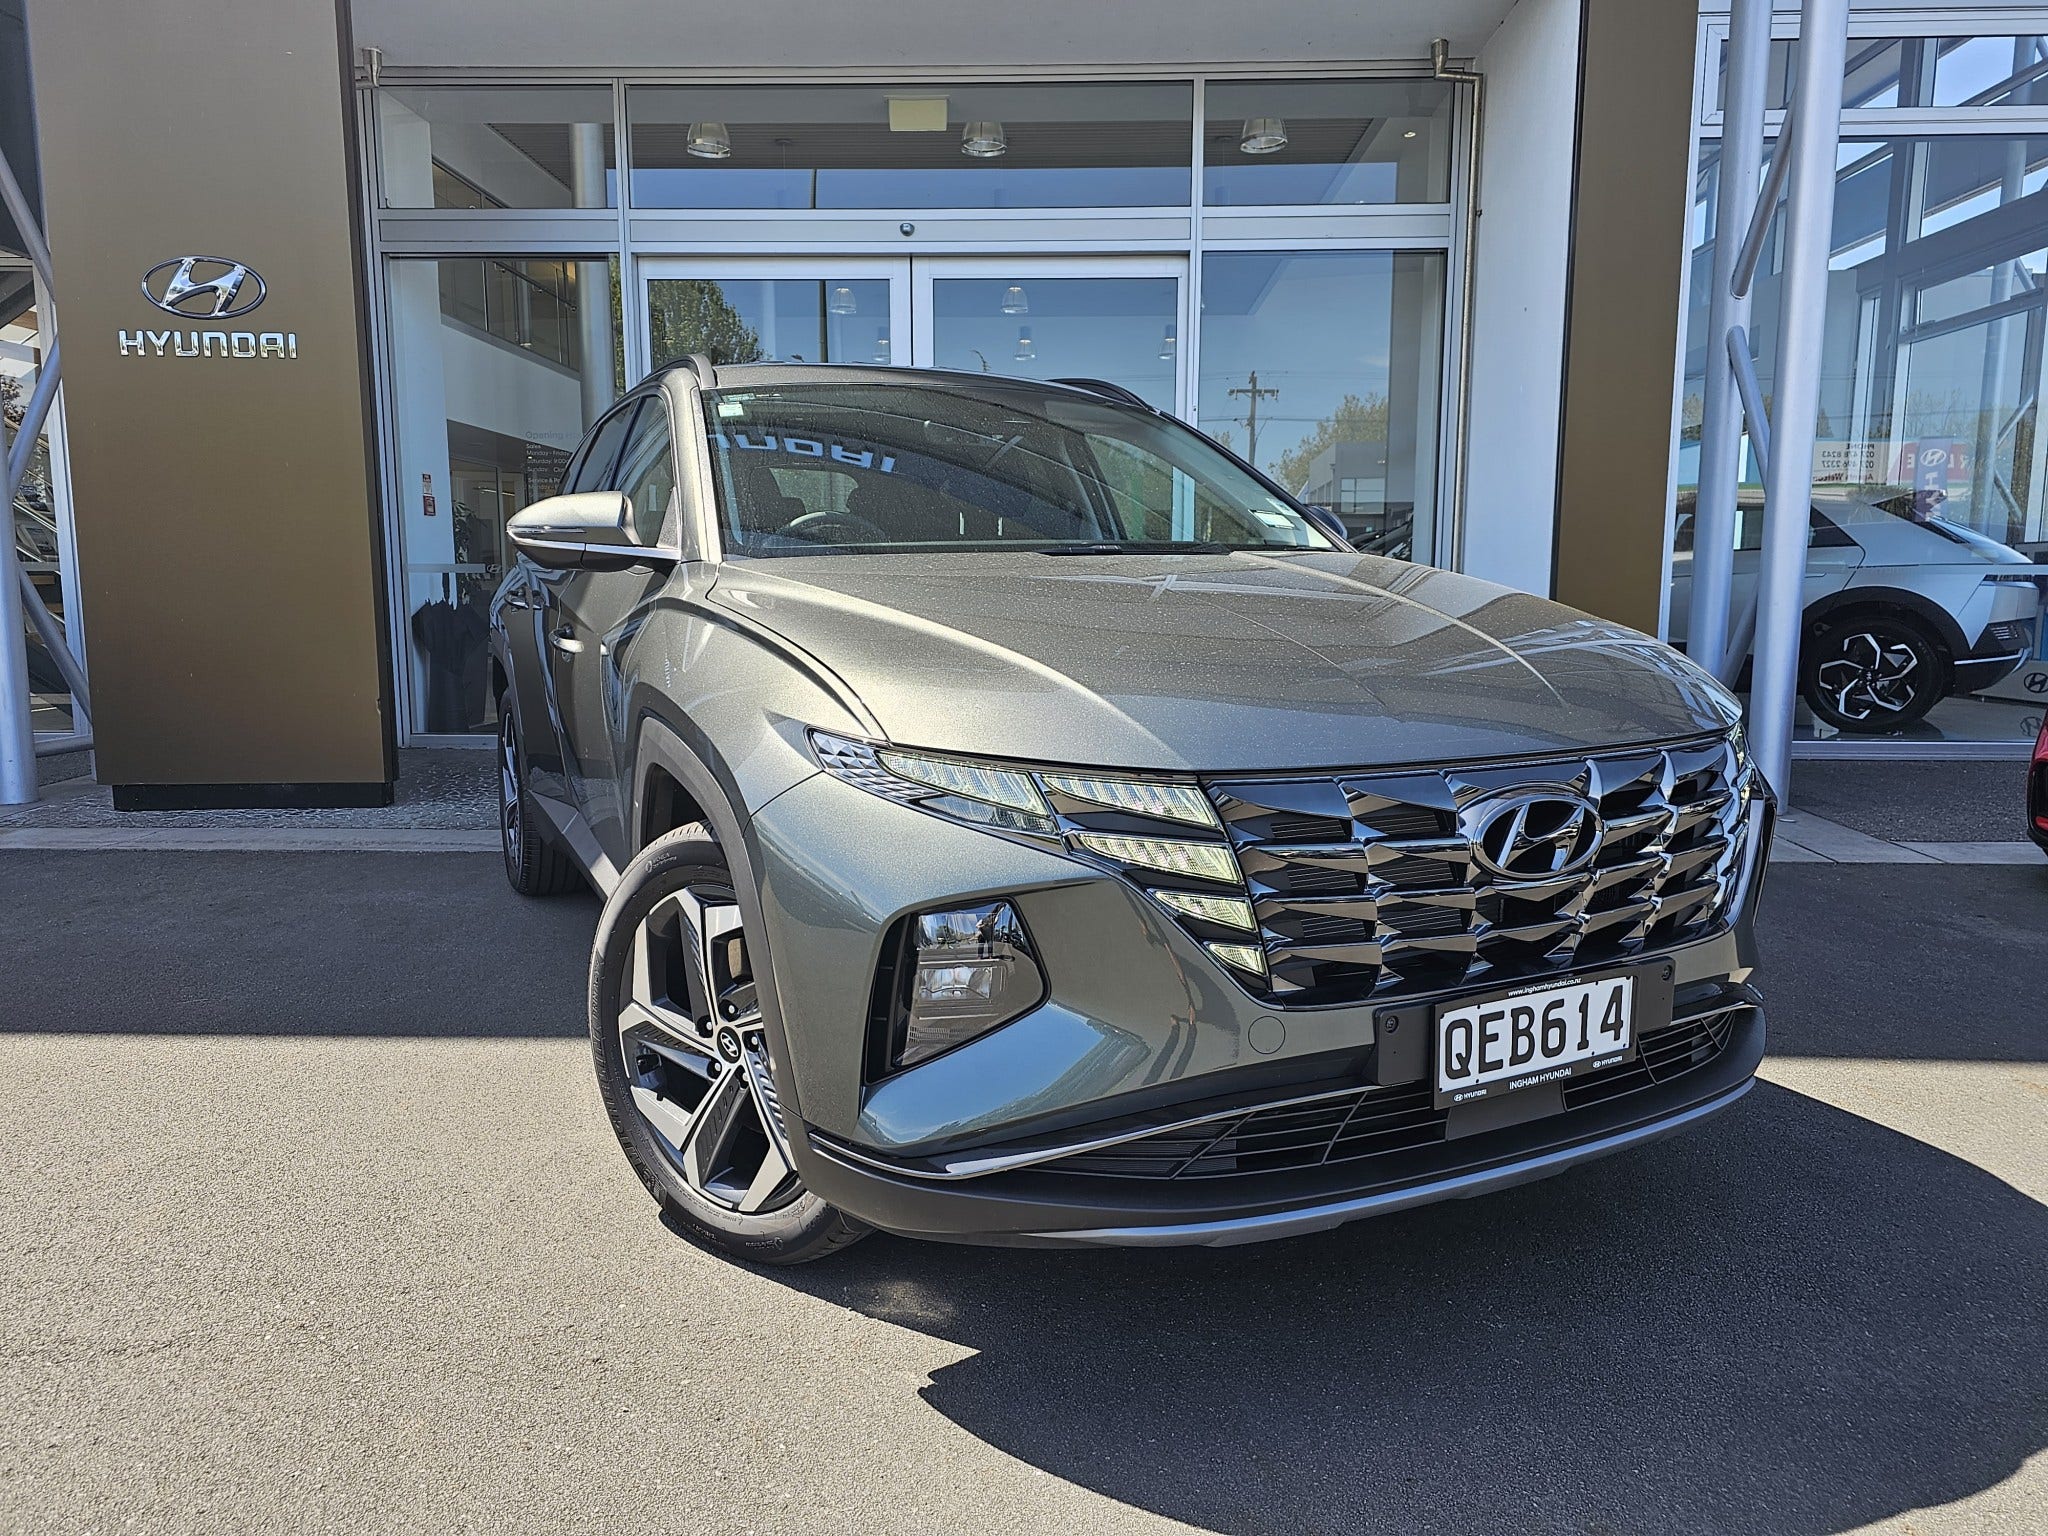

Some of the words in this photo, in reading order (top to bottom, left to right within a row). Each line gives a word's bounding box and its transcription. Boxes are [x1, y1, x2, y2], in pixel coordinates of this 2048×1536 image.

[118, 329, 298, 360] HYUNDAI
[1445, 985, 1624, 1079] QEB614
[1601, 1055, 1623, 1066] HYUNDAI
[1509, 1074, 1539, 1090] INGHAM
[1539, 1067, 1572, 1083] HYUNDAI
[1463, 1089, 1488, 1100] HYUNDAI
